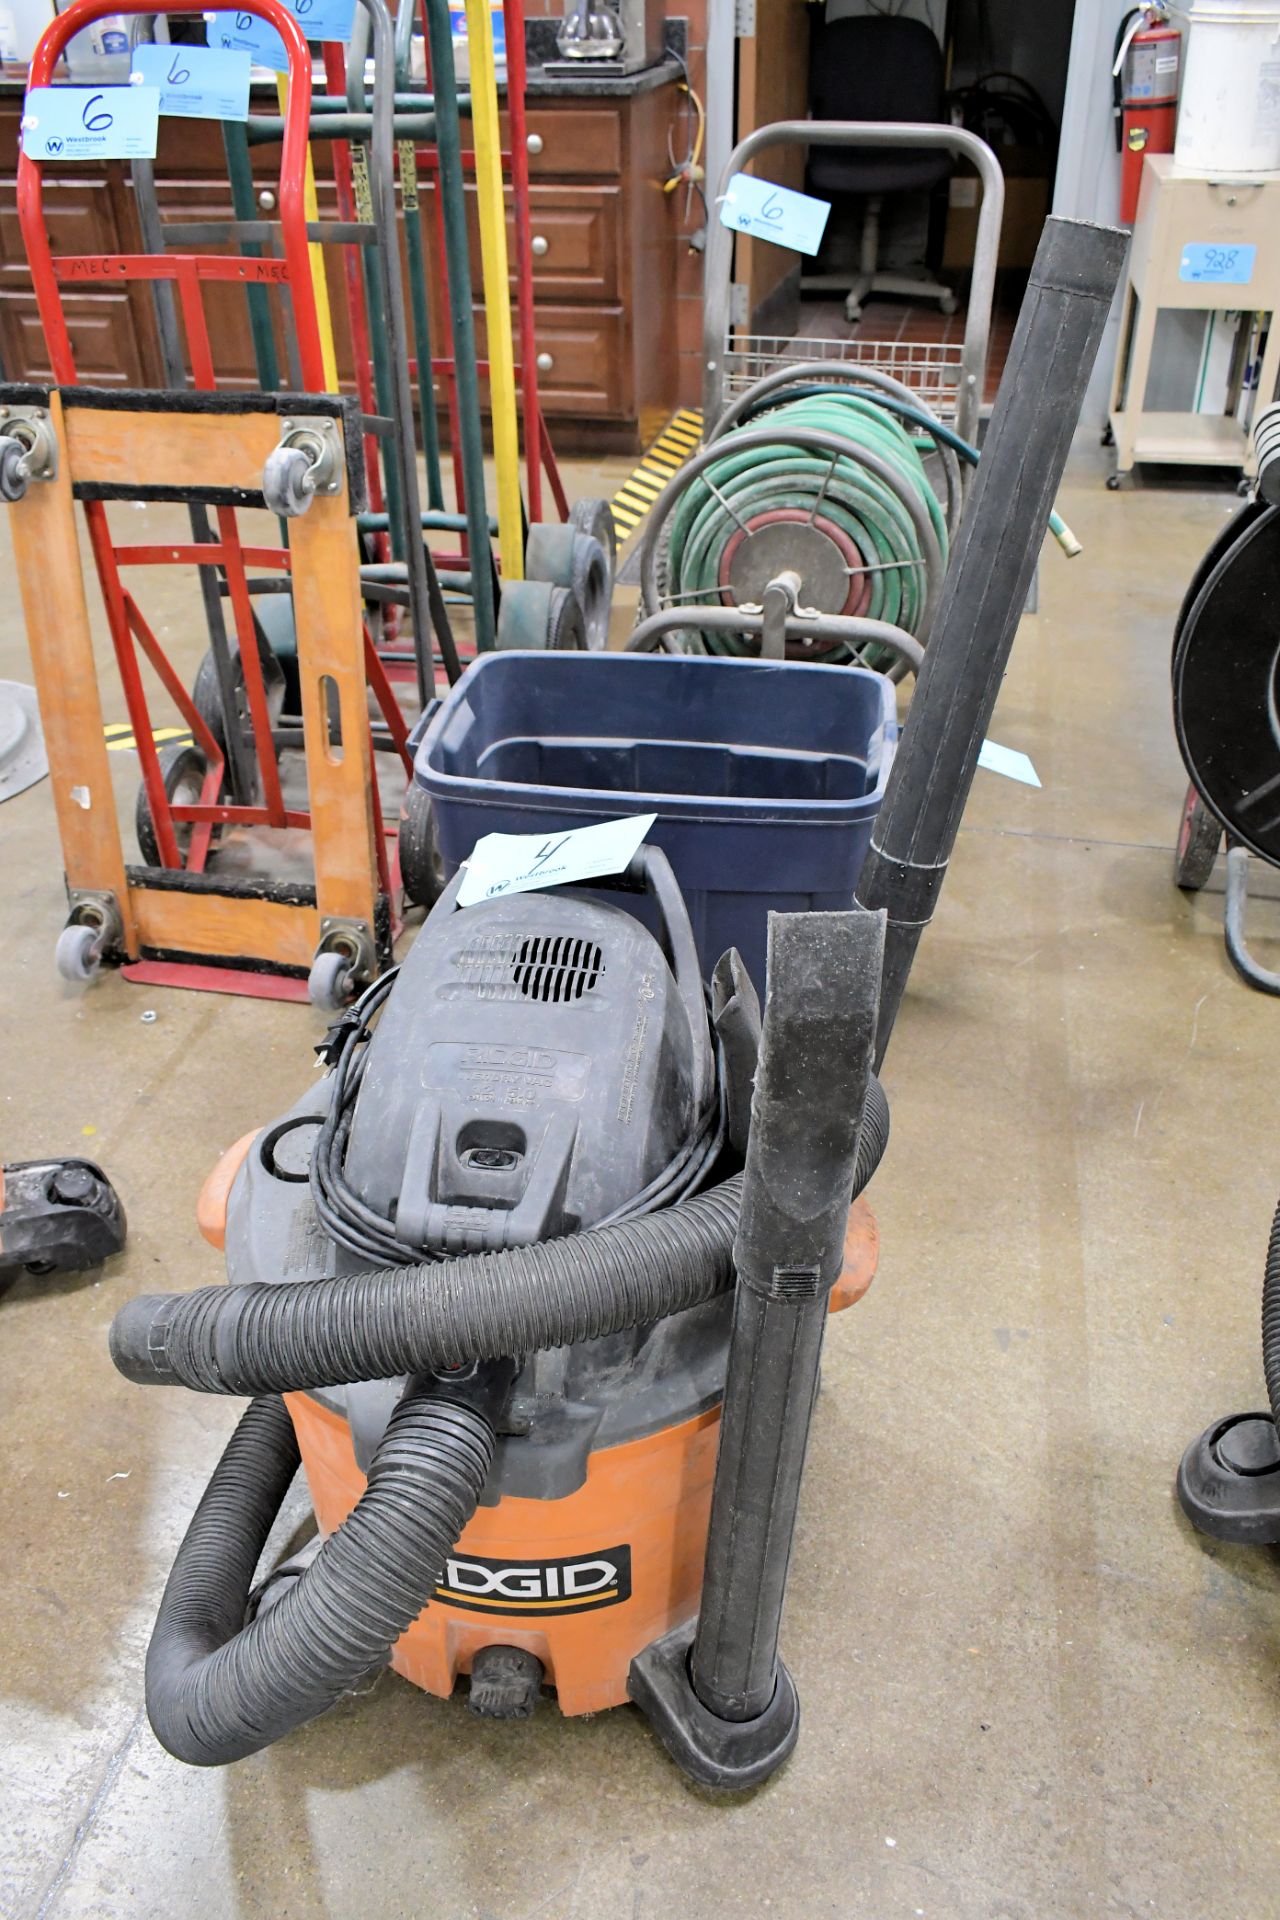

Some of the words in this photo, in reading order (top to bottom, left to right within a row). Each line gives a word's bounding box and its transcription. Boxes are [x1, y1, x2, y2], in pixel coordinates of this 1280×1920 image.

[167, 52, 190, 84] 6
[82, 94, 113, 131] 6
[761, 192, 784, 220] 6
[1205, 249, 1239, 269] 928
[534, 835, 572, 875] 4
